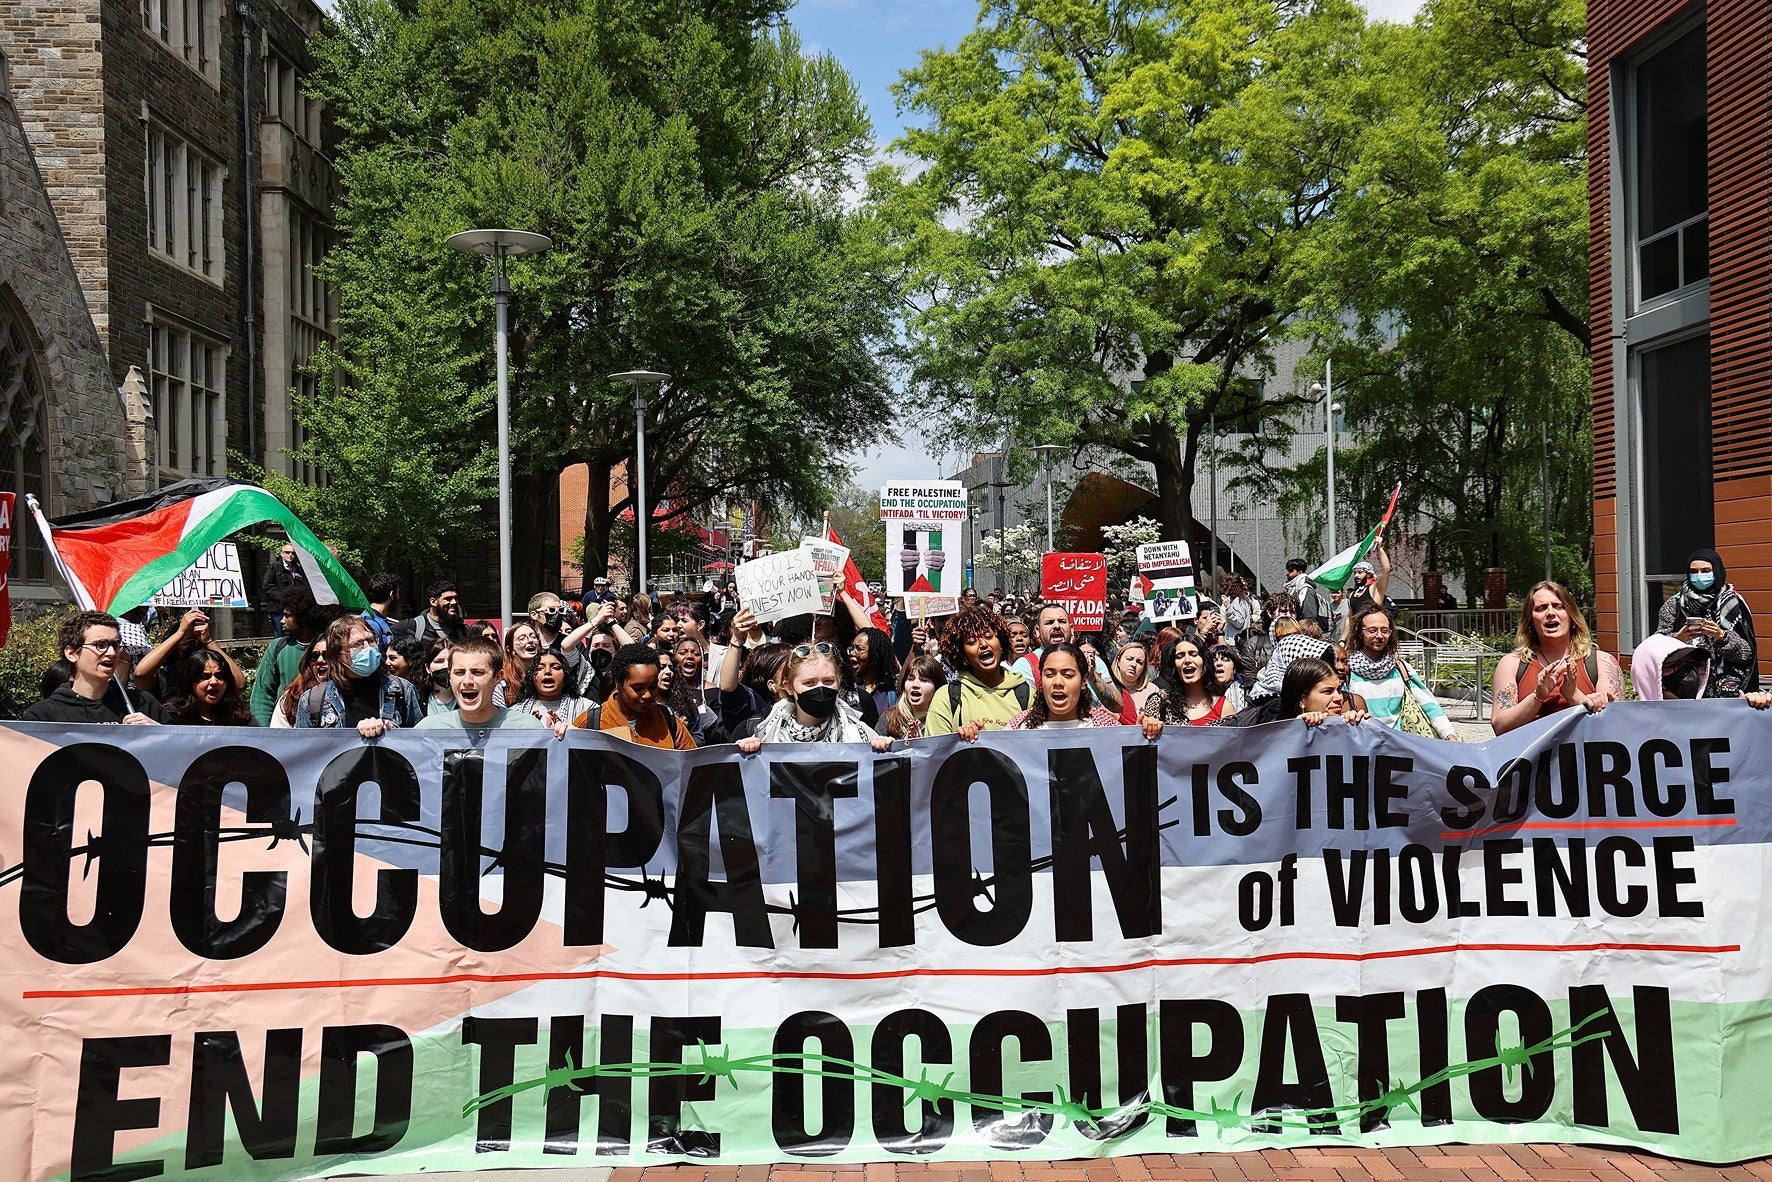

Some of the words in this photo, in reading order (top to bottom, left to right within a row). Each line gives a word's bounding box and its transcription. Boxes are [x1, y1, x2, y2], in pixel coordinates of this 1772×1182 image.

[888, 488, 910, 497] FREE
[912, 488, 961, 498] PALESTINE!
[881, 499, 898, 507] END
[900, 499, 916, 507] THE
[917, 499, 966, 509] OCCUPATION
[881, 509, 914, 518] INTIFADA
[932, 510, 966, 519] VICTORY!
[1143, 546, 1162, 554] DOWN
[1162, 544, 1179, 552] WITH
[1143, 551, 1180, 561] NETANYAHU
[1060, 557, 1106, 570] الانتفاضة
[1138, 562, 1151, 570] END
[1151, 558, 1191, 568] IMPERIALISM
[188, 570, 201, 579] AN
[736, 556, 782, 588] BLOOD
[786, 553, 803, 571] IS
[758, 575, 786, 594] YOUR
[1046, 578, 1073, 592] النصر
[1073, 574, 1095, 590] حتى
[787, 585, 813, 603] NOW
[18, 741, 1162, 965] OCCUPATION
[1191, 761, 1263, 837] IS
[1286, 754, 1414, 831] THE
[1440, 737, 1737, 830] SOURCE
[1238, 852, 1298, 932] of
[1323, 835, 1705, 928] VIOLENCE
[72, 1023, 414, 1182] END
[461, 1014, 723, 1160] THE
[770, 983, 1681, 1158] OCCUPATION
